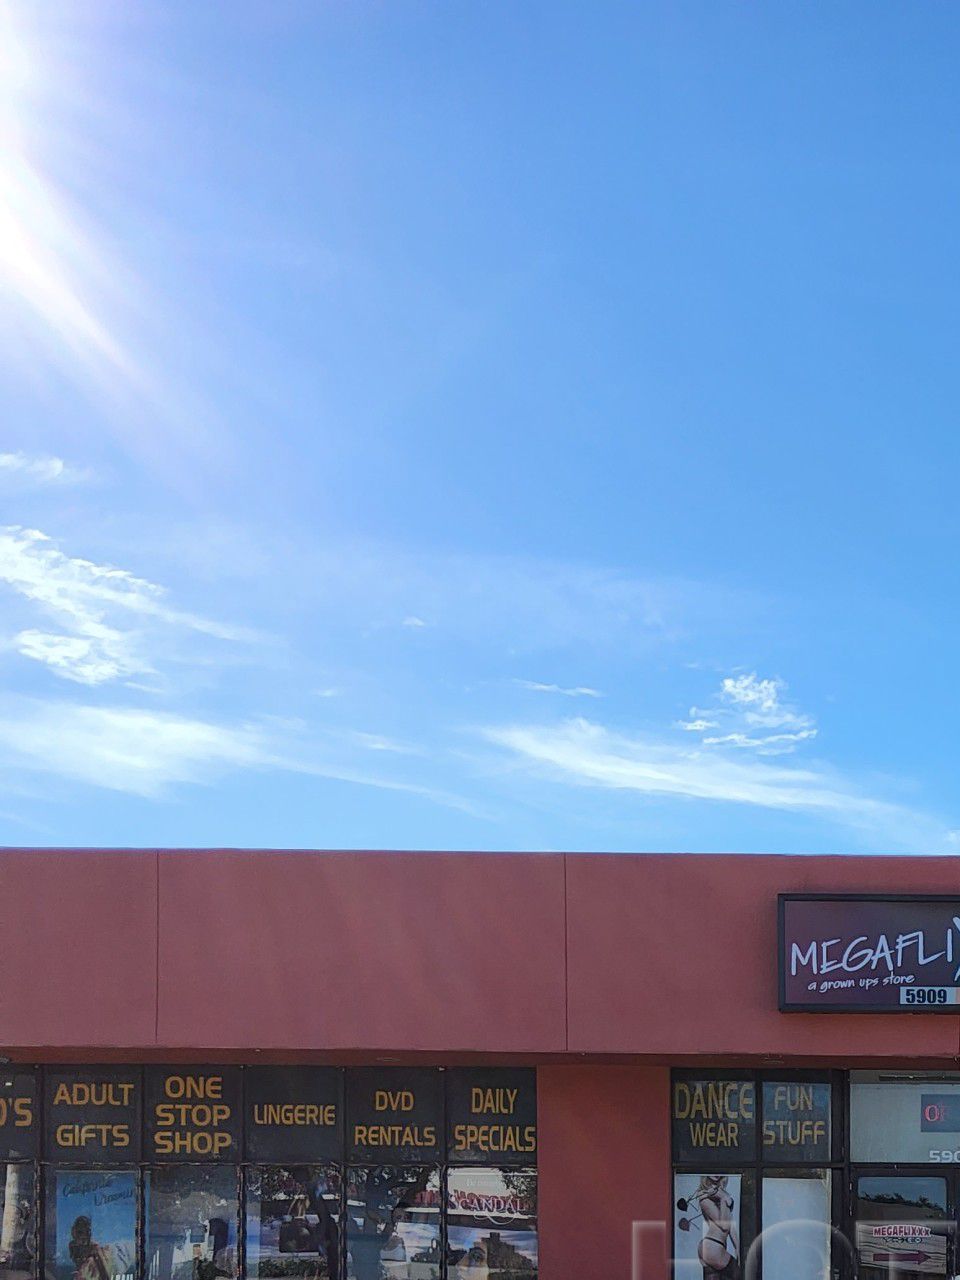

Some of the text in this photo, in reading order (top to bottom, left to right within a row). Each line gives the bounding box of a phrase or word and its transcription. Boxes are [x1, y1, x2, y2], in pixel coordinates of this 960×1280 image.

[808, 972, 915, 993] a grown ups store
[905, 988, 947, 1003] 5909
[53, 1083, 134, 1106] ADULT
[165, 1076, 222, 1099] ONE
[774, 1086, 813, 1111] FUN
[375, 1091, 414, 1111] DVD
[471, 1087, 517, 1114] DAILY
[675, 1082, 753, 1119] DANCE
[155, 1104, 231, 1126] STOP
[254, 1104, 335, 1125] LINGERIE
[56, 1124, 130, 1147] GIFTS
[154, 1131, 232, 1154] SHOP
[355, 1125, 436, 1147] RENTALS
[454, 1125, 536, 1151] SPECIALS
[690, 1122, 738, 1147] WEAR
[763, 1120, 825, 1145] STUFF
[873, 1225, 931, 1237] MEGAFLIXXX
